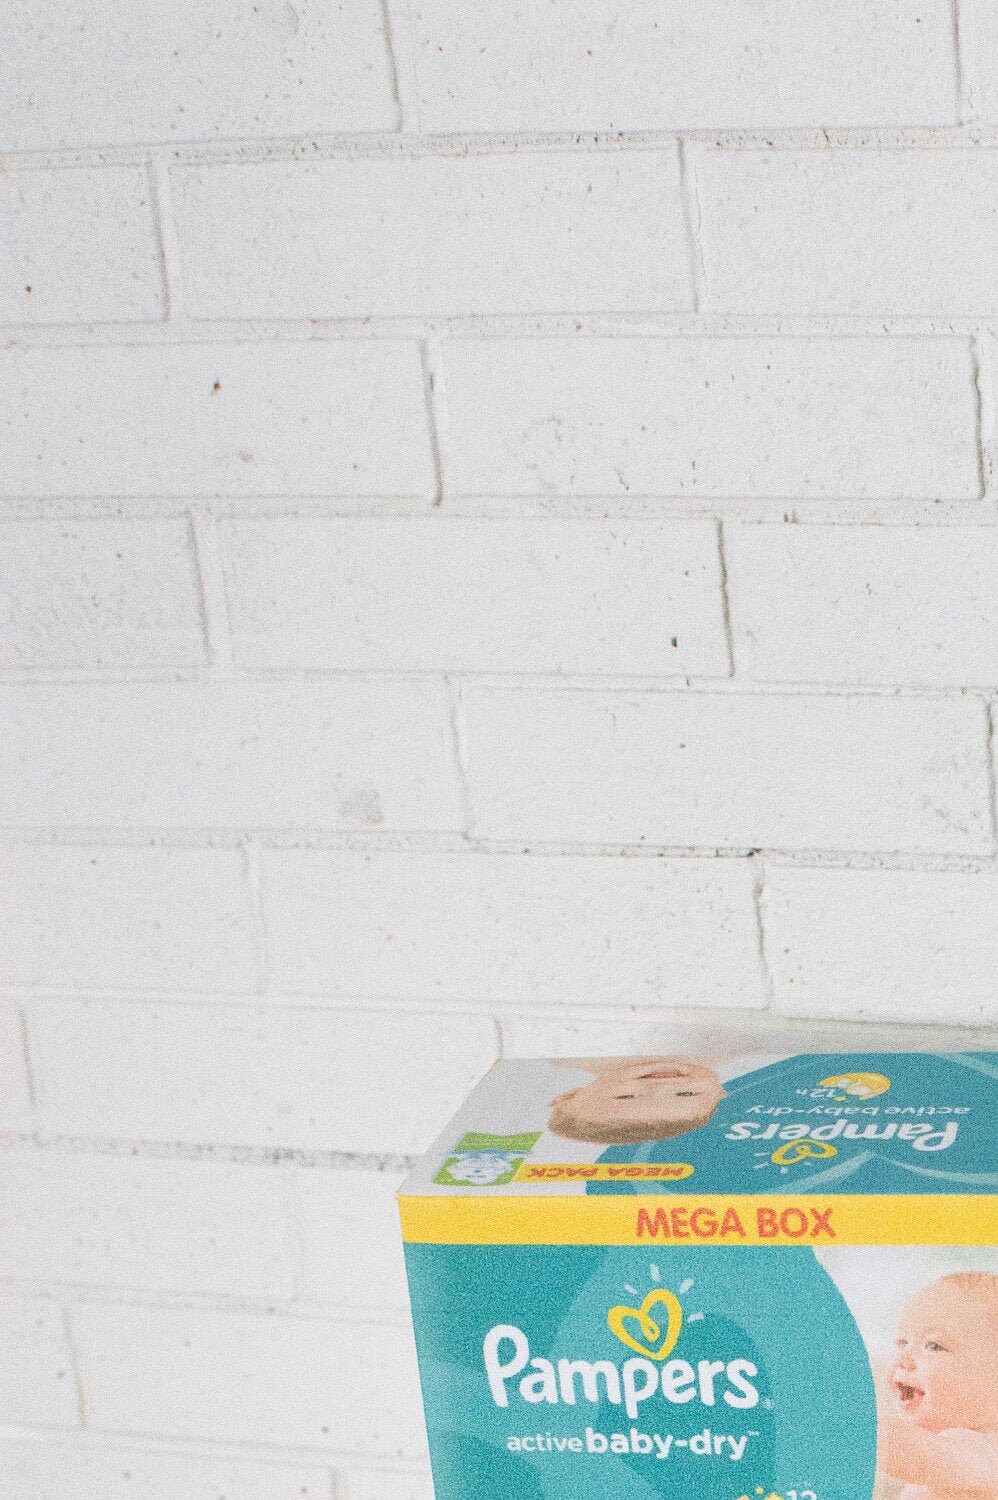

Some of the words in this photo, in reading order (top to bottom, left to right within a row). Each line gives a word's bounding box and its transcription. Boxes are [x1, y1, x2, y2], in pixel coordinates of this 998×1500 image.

[745, 1104, 878, 1117] baby-dry
[884, 1106, 971, 1116] active
[725, 1118, 960, 1152] Pampers
[527, 1167, 599, 1178] PACK
[607, 1167, 685, 1178] MEGA
[635, 1206, 747, 1238] MEGA
[756, 1206, 838, 1238] BOX
[482, 1323, 760, 1420] Pampers
